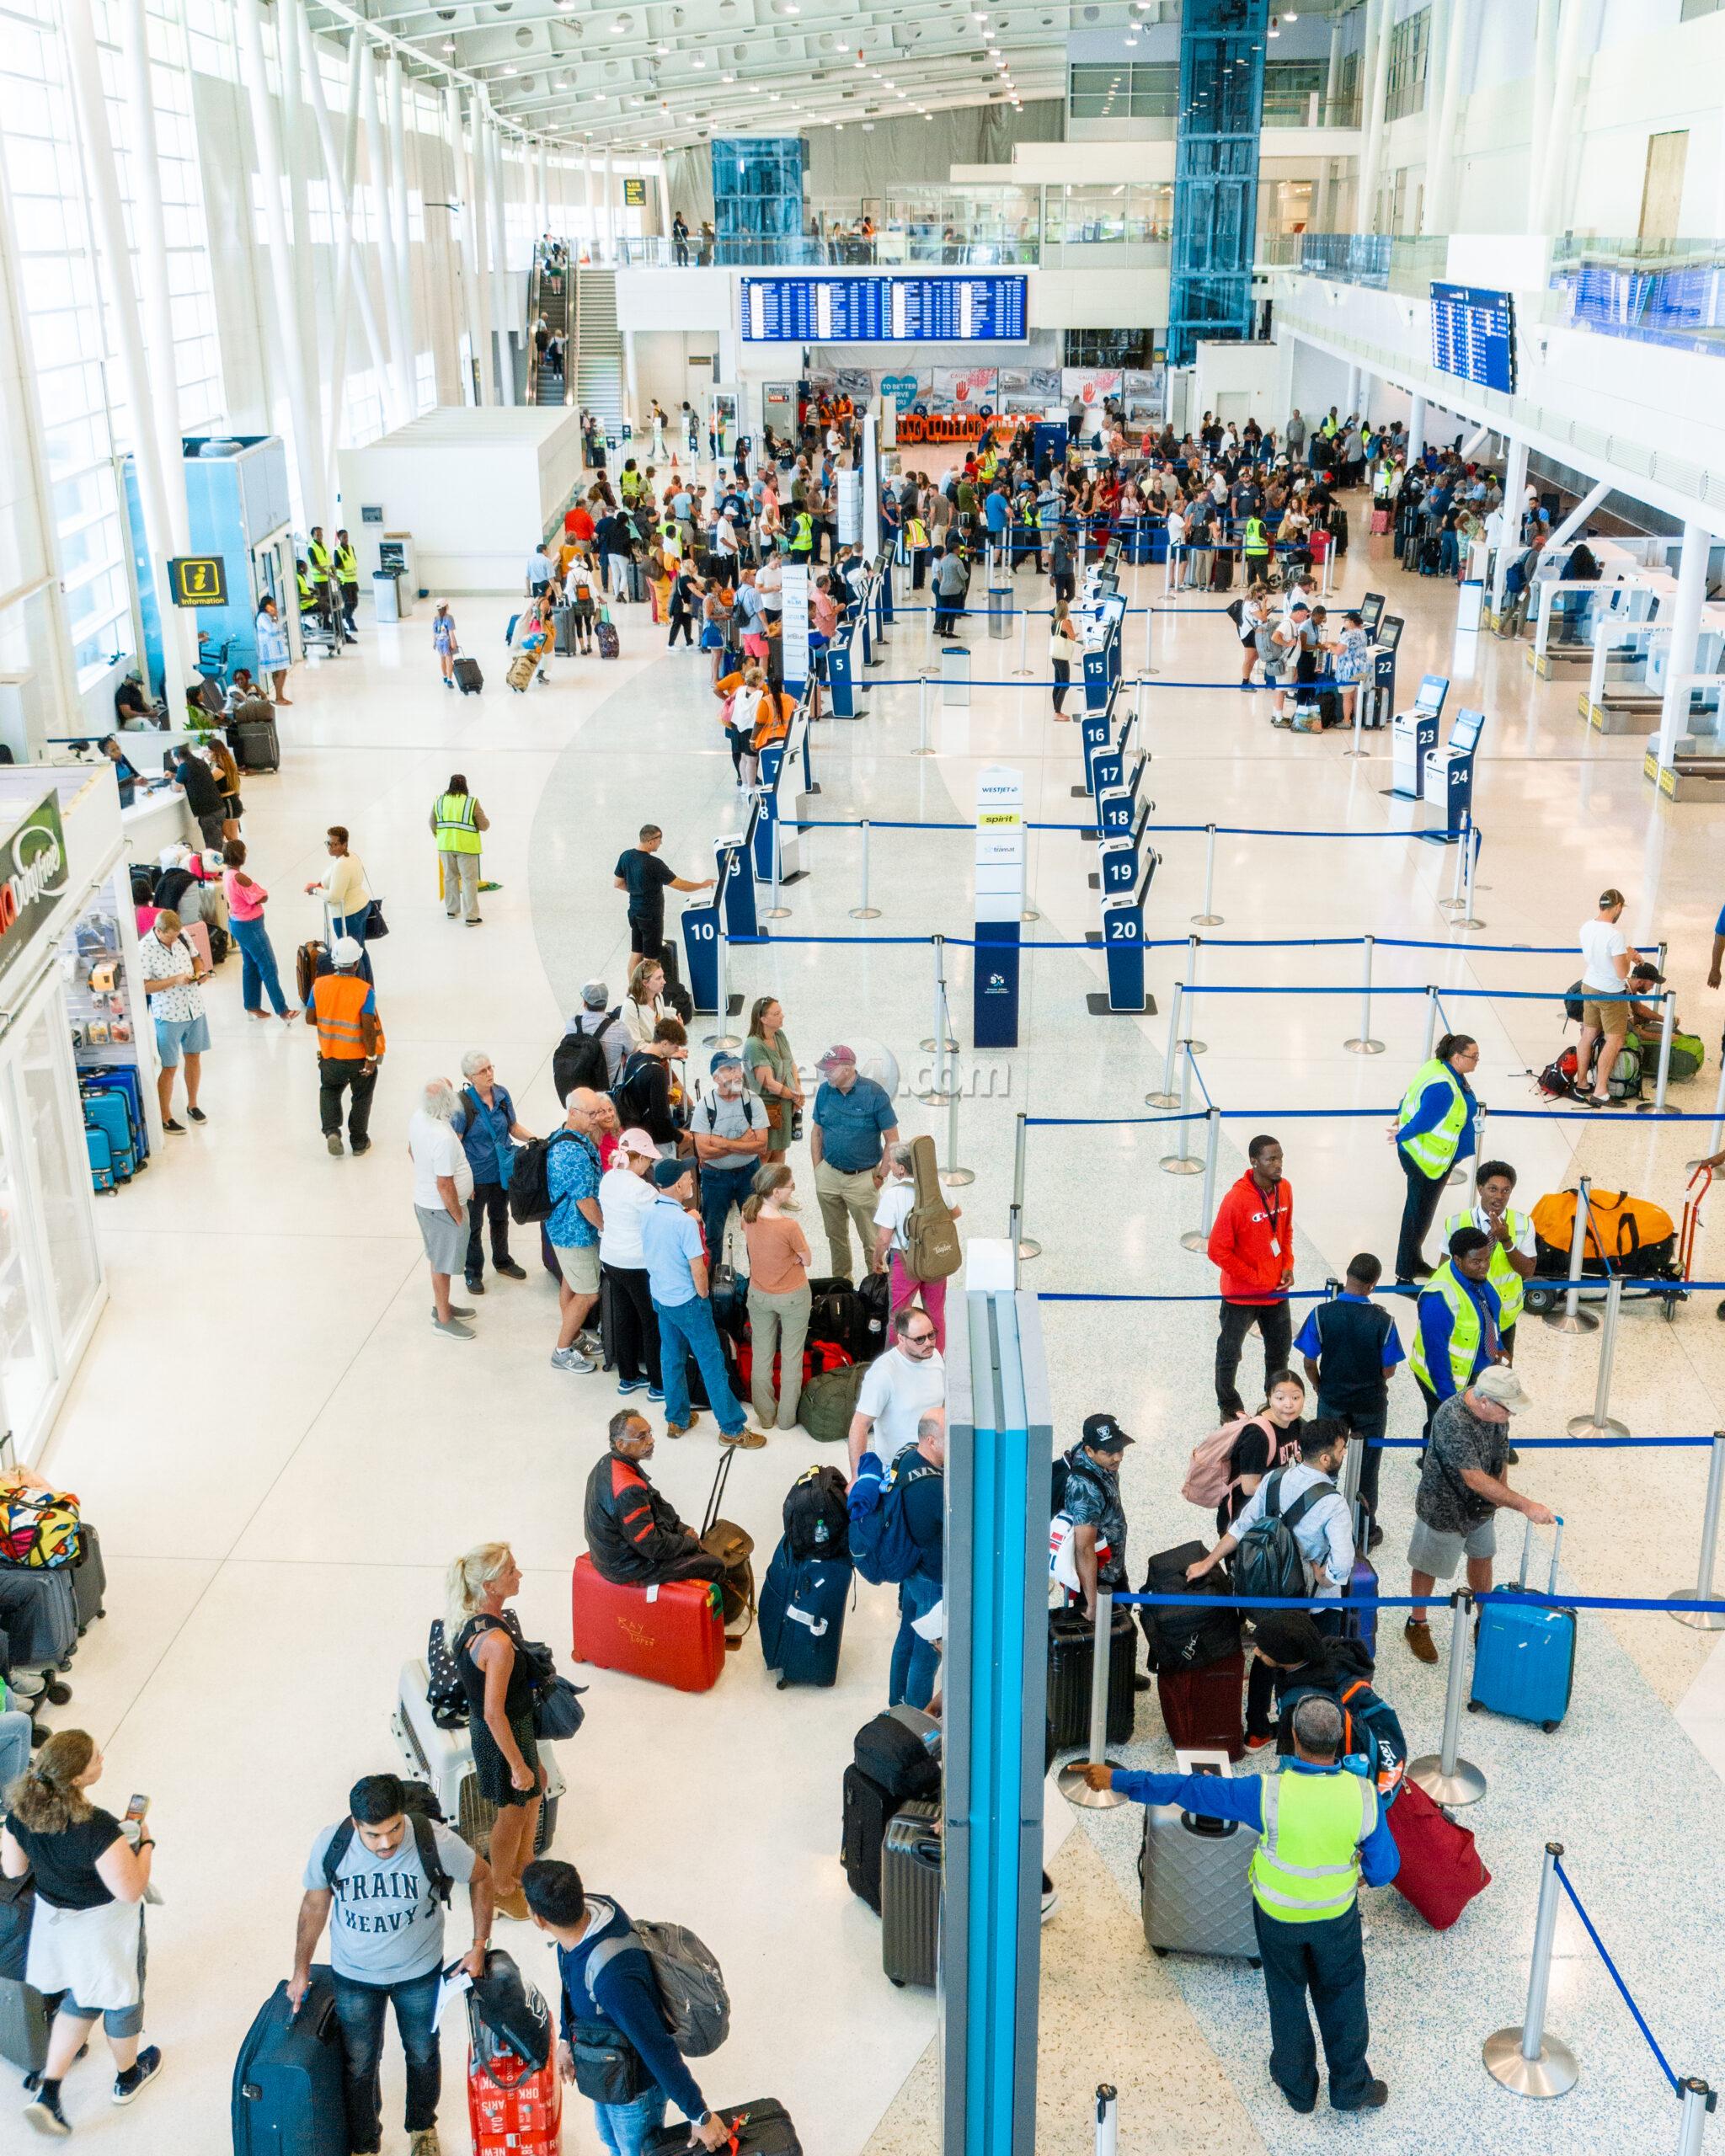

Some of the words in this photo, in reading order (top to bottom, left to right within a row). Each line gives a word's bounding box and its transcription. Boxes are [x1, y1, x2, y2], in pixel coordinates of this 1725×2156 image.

[181, 597, 225, 606] Information
[836, 659, 844, 670] 5
[1088, 662, 1103, 674] 15
[1378, 661, 1392, 674] 22
[1087, 728, 1105, 743] 16
[1419, 730, 1434, 744] 23
[771, 760, 780, 774] 7
[1100, 766, 1119, 782] 17
[1451, 770, 1469, 785] 24
[760, 806, 769, 819] 8
[985, 815, 1013, 825] spirit
[1108, 810, 1129, 825] 18
[730, 861, 741, 877] 9
[1110, 864, 1132, 880] 19
[691, 923, 714, 941] 10
[1112, 921, 1137, 939] 20
[932, 1244, 953, 1255] Taylor
[617, 1616, 644, 1635] RAY
[336, 1871, 419, 1903] TRAIN
[344, 1903, 419, 1933] HEAVY
[481, 2099, 505, 2111] ARIS
